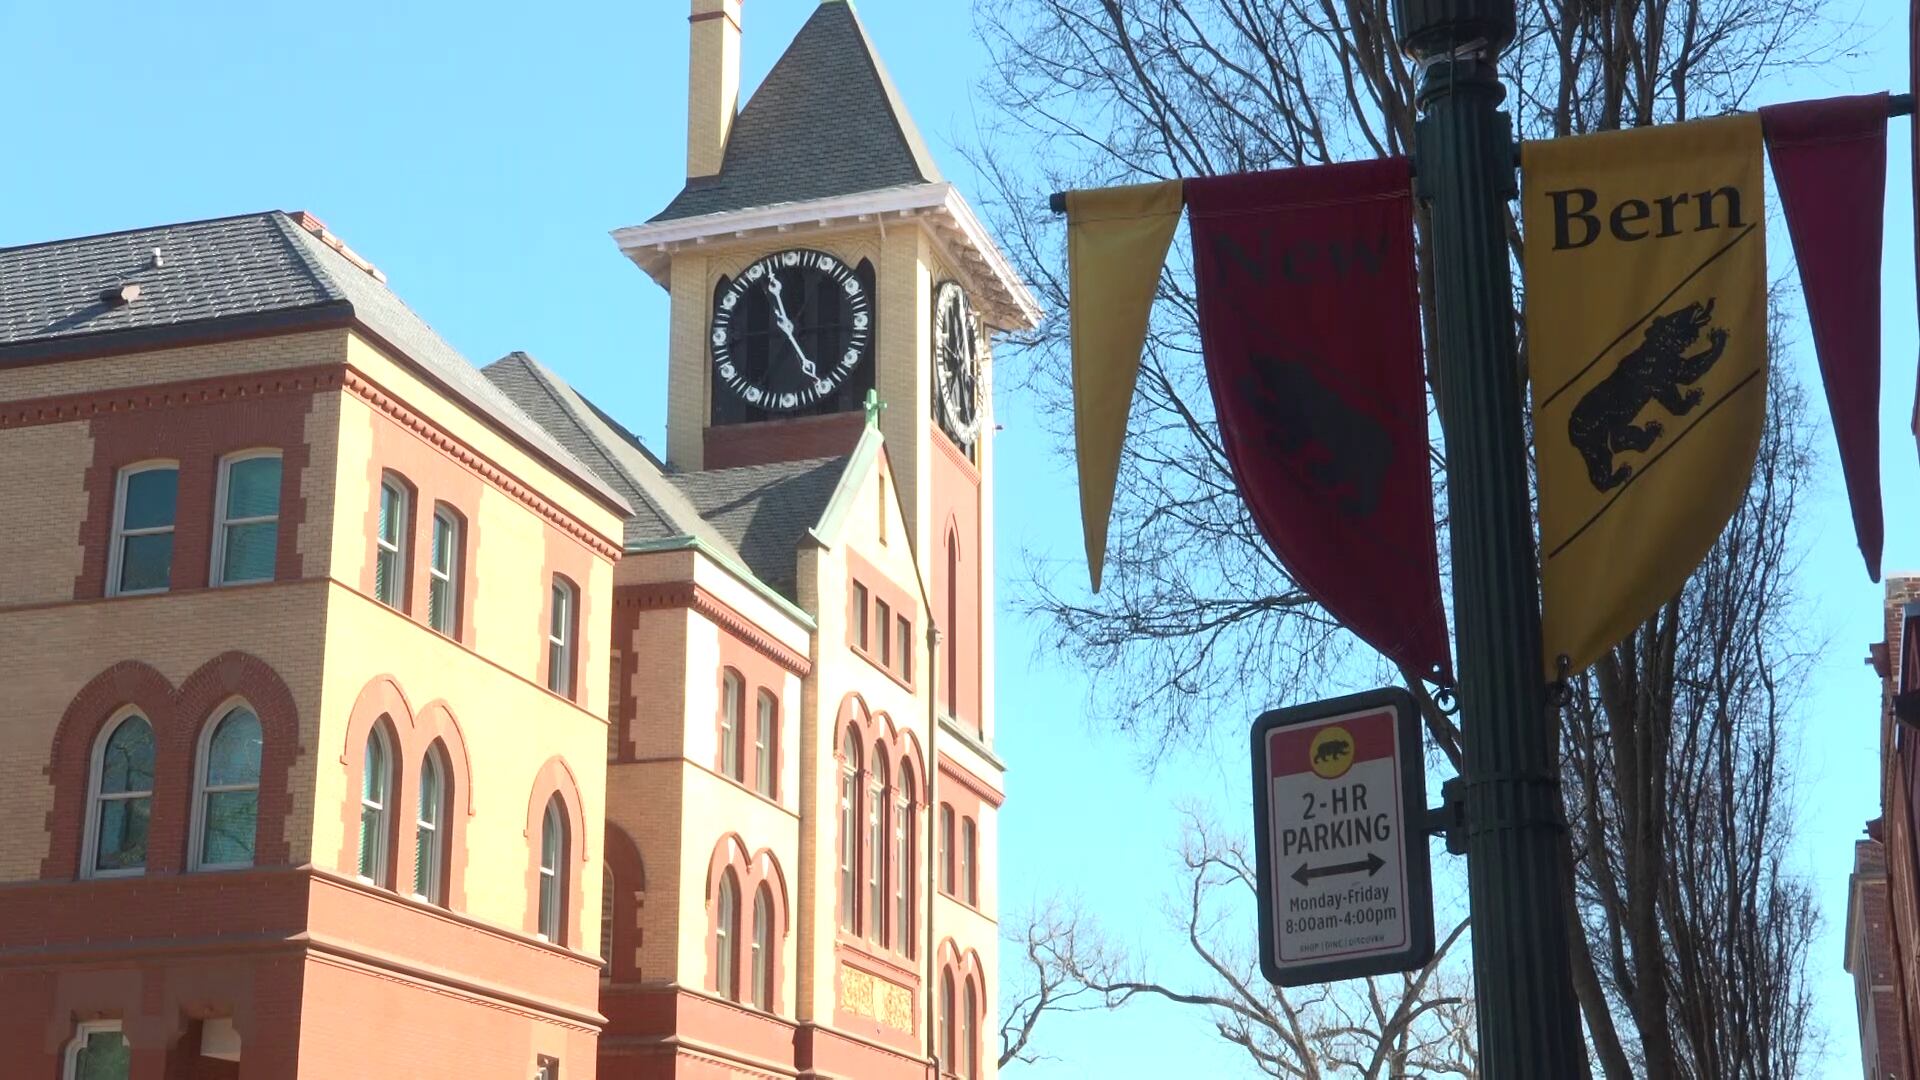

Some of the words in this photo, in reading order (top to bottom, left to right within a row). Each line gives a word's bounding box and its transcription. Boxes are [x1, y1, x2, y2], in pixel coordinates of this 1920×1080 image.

[1545, 185, 1747, 251] Bern
[1210, 231, 1390, 288] New
[1302, 783, 1368, 820] 2-HR
[1282, 813, 1391, 856] PARKING
[1289, 886, 1390, 913] Monday-Friday
[1285, 906, 1397, 934] 8:00am-4:00pm
